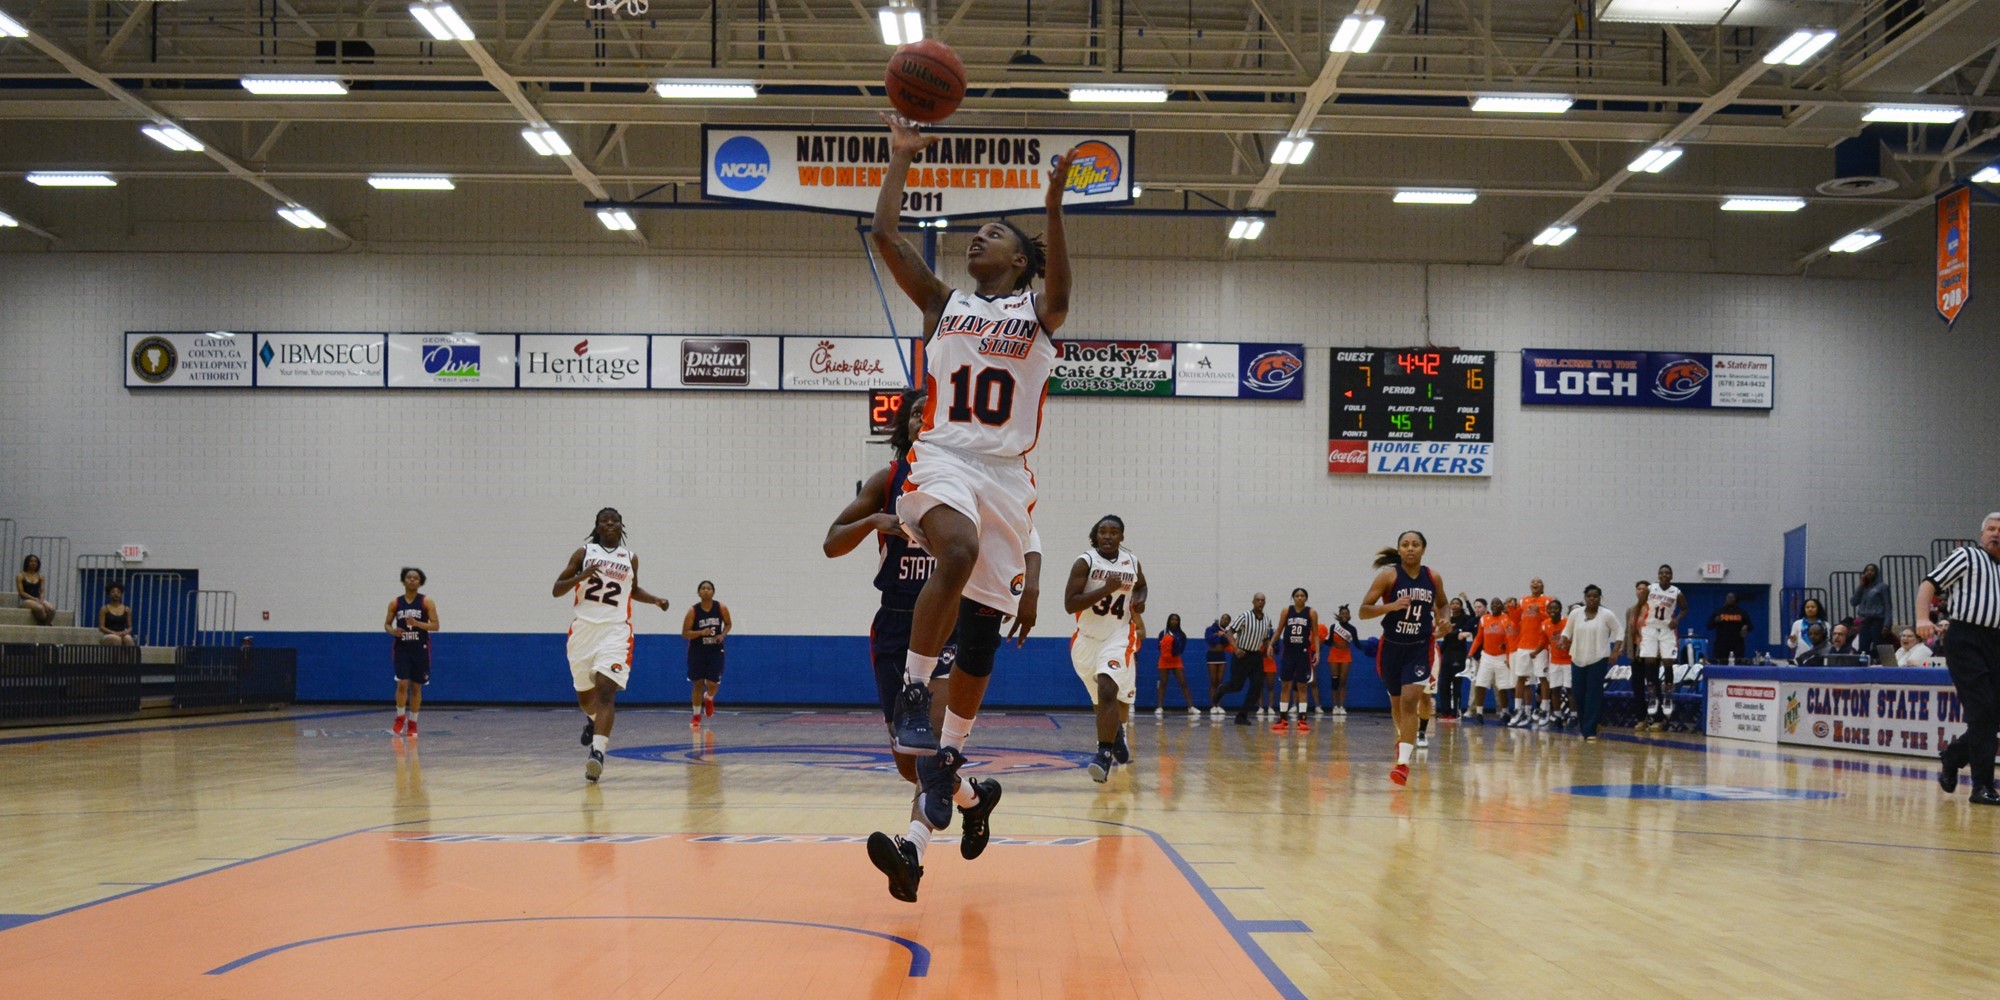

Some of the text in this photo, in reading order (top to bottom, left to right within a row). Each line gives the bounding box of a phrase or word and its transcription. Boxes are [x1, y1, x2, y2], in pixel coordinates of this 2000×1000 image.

[902, 60, 950, 91] Wilson
[797, 136, 890, 163] NATIONA
[720, 163, 768, 178] NCAA
[798, 166, 1041, 188] WOMEN' BASKETBALL
[901, 192, 942, 212] 2011
[937, 315, 1040, 342] CLAYTON
[194, 339, 236, 347] CLAYTON
[978, 338, 1032, 360] STATE
[229, 350, 242, 358] GA
[280, 343, 381, 364] IBMSECU
[423, 346, 480, 374] Own
[685, 351, 746, 367] DRURY
[810, 344, 884, 376] Chick-fil-A
[1063, 343, 1158, 366] Rocky's
[1337, 352, 1374, 362] GUEST
[1452, 354, 1485, 364] HOME
[181, 361, 247, 369] DEVELOPMENT
[529, 350, 639, 380] Heritage
[1398, 353, 1440, 375] 4:42
[1535, 359, 1593, 368] WELCOME
[1596, 360, 1612, 368] TO
[189, 372, 240, 380] AUTHORITY
[556, 375, 604, 383] BANK
[1054, 365, 1167, 379] Café & Pizza
[1359, 366, 1371, 387] 7
[1466, 369, 1484, 390] 16
[793, 377, 901, 387] Forest Park Dwarf House
[1062, 379, 1154, 390] 404-363-4646
[1534, 370, 1637, 396] LOCH
[949, 364, 1016, 427] 10
[1382, 386, 1416, 395] PERIOD
[1391, 414, 1411, 430] 45
[1465, 415, 1476, 431] 2
[1372, 442, 1491, 455] HOME OF THE
[1377, 456, 1485, 474] LAKERS
[124, 546, 139, 557] EXIT
[899, 556, 937, 580] STAT
[1707, 564, 1721, 574] EXIT
[584, 577, 622, 607] 22
[1397, 588, 1433, 603] COLUMBUS
[1092, 594, 1126, 620] 34
[1405, 605, 1422, 620] 14
[1655, 606, 1665, 620] 11
[401, 631, 419, 641] STATE
[1291, 625, 1303, 635] 20
[1395, 621, 1422, 635] STATE
[1807, 688, 1967, 722] CLAYTON STATE UN
[1833, 720, 1870, 745] HOME
[1877, 729, 1893, 747] OF
[1901, 731, 1928, 750] THE
